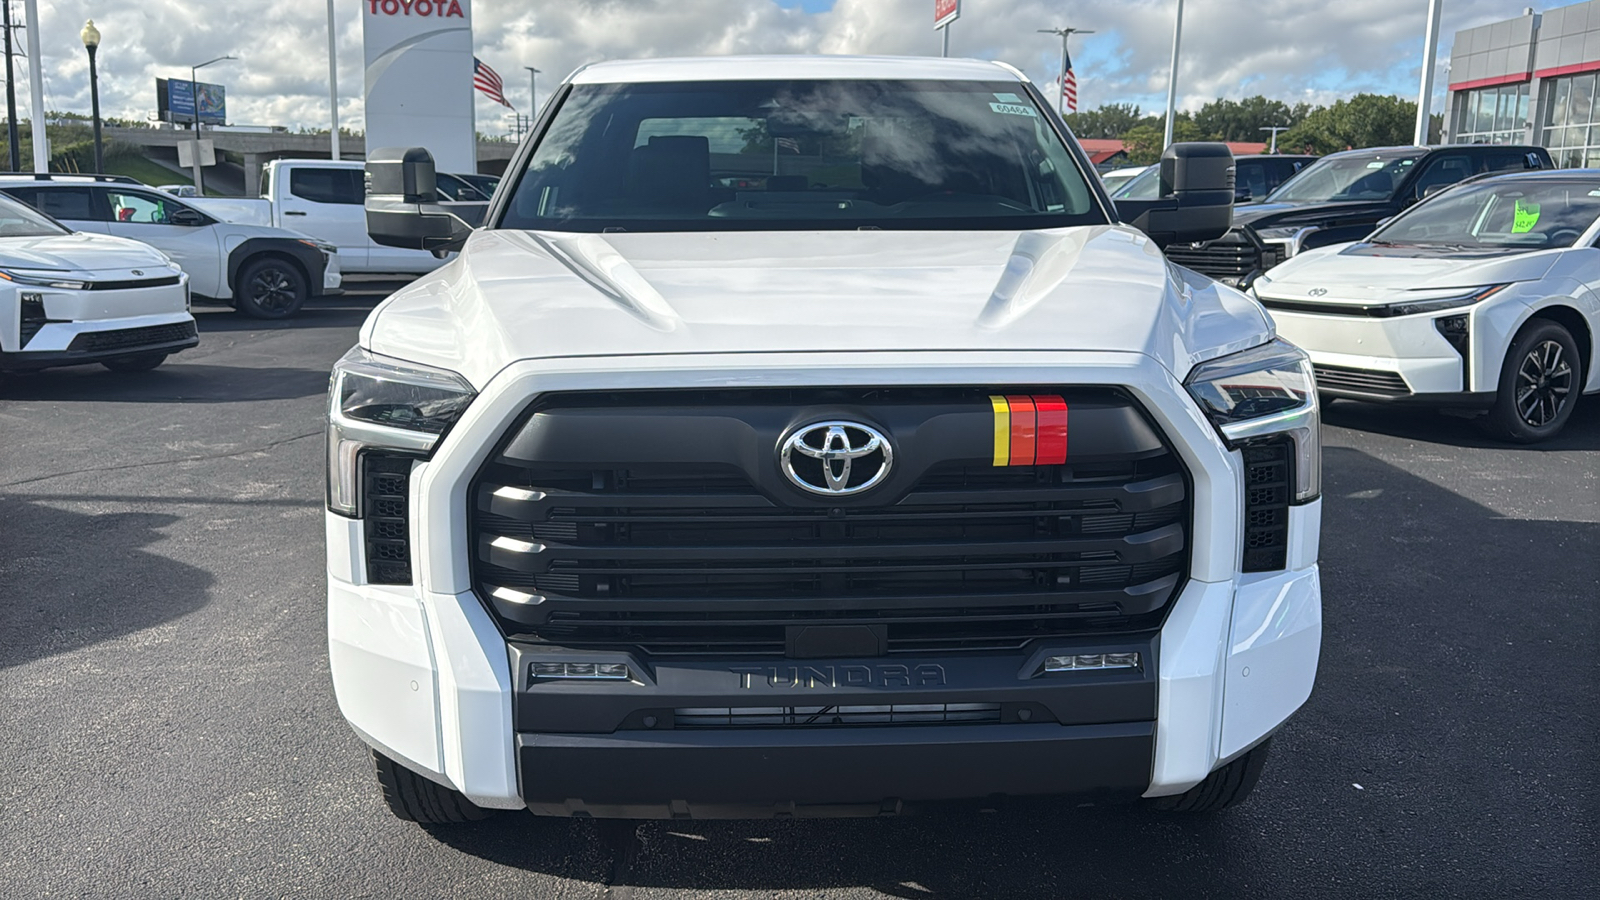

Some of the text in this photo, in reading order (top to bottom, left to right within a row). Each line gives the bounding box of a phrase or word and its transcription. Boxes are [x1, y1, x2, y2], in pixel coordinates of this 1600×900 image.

[367, 0, 464, 18] TOYOTA
[996, 105, 1030, 115] 60464
[728, 664, 947, 689] TUNDRA
